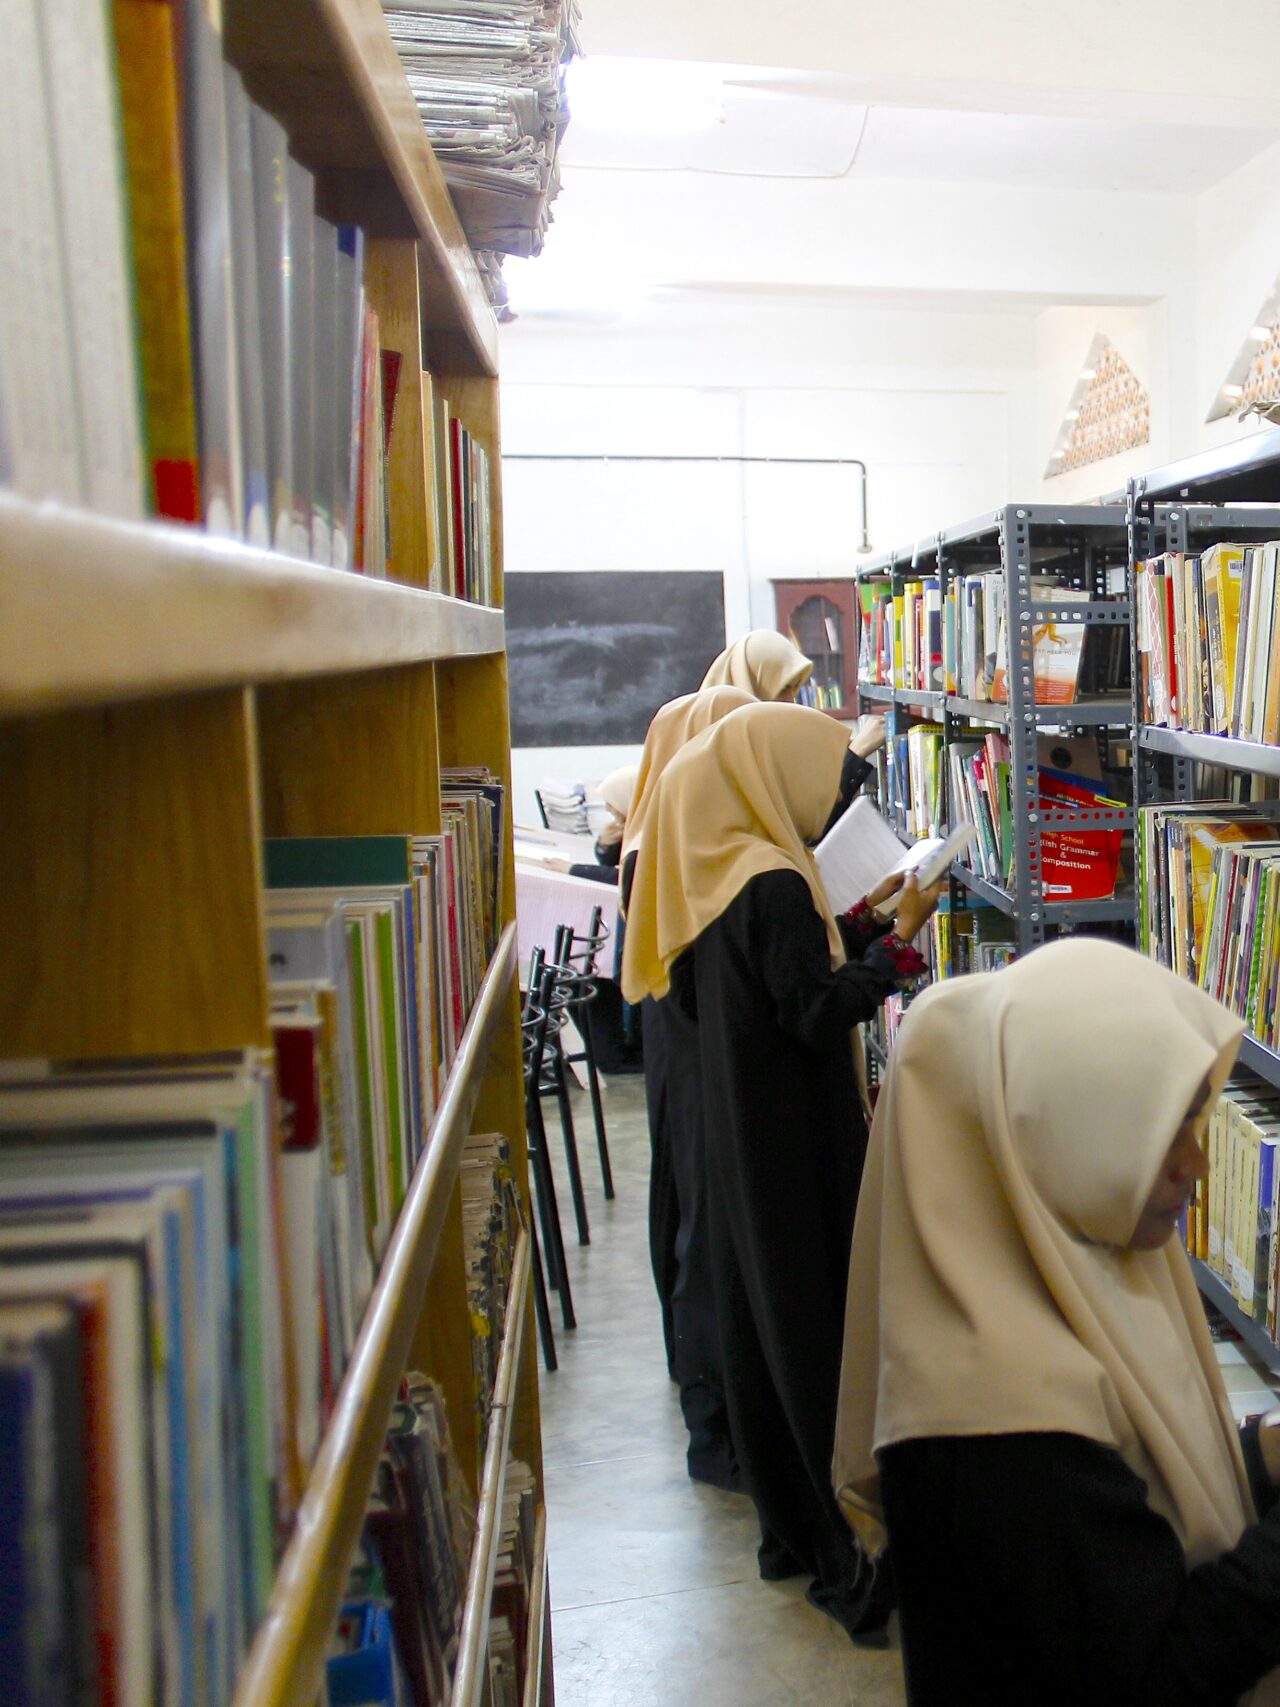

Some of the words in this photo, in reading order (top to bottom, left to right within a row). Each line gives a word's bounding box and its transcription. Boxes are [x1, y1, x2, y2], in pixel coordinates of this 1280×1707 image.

[1061, 834, 1085, 845] School
[1040, 839, 1057, 849] lish
[1059, 843, 1100, 857] Grammar
[1059, 851, 1067, 859] &
[1040, 856, 1091, 870] omposition
